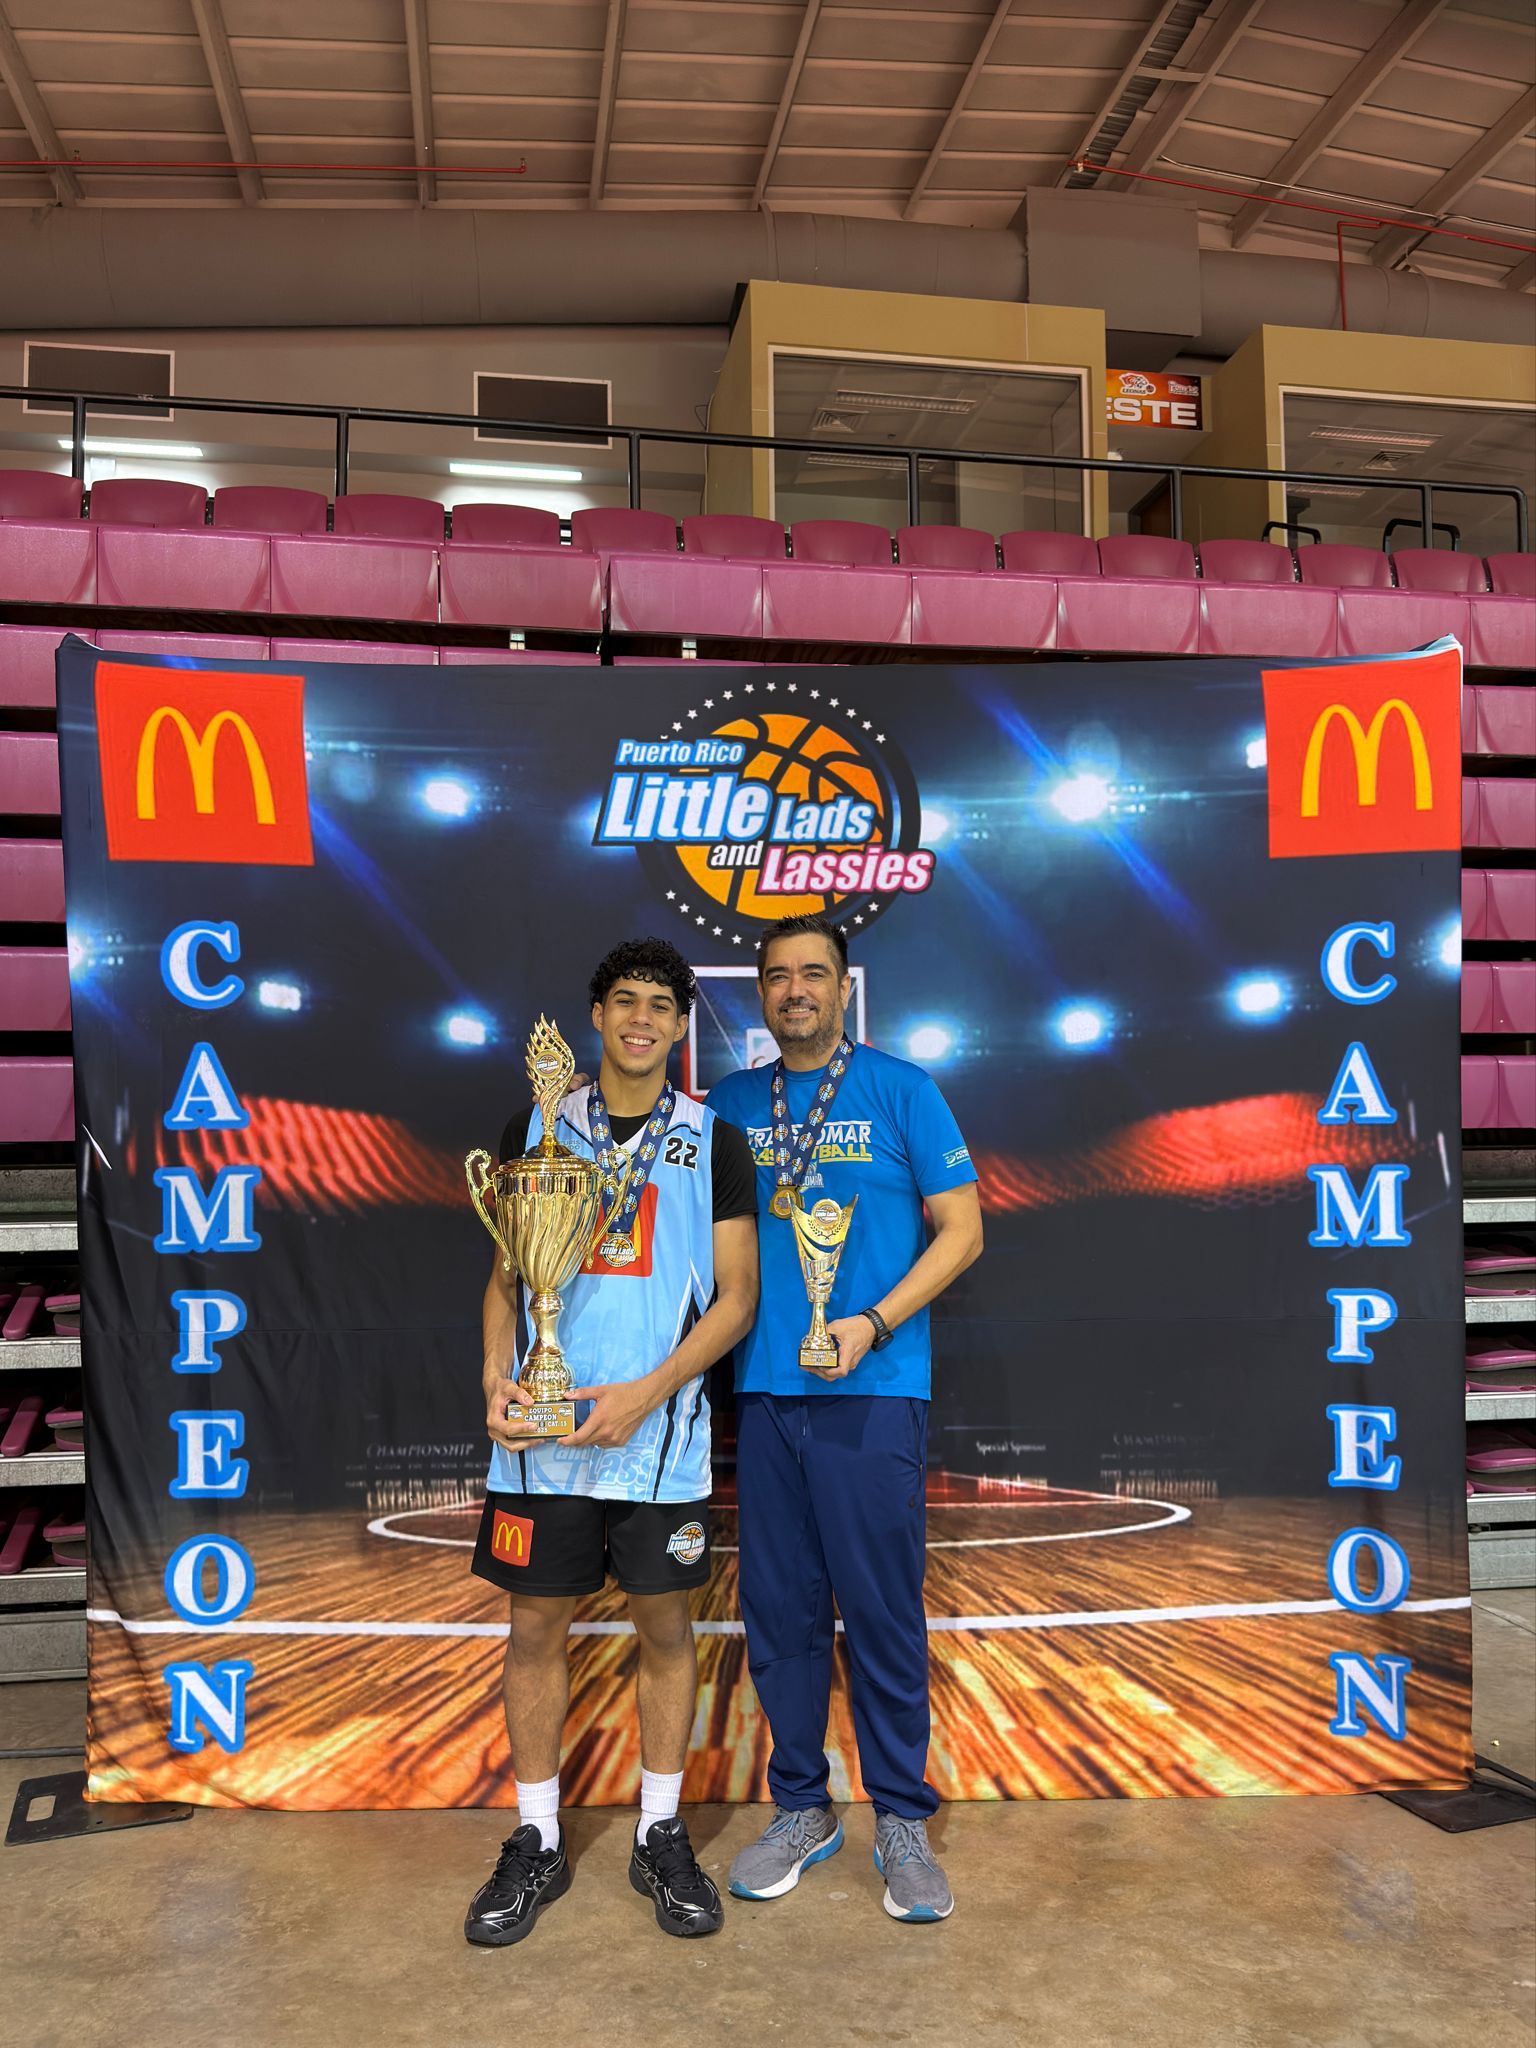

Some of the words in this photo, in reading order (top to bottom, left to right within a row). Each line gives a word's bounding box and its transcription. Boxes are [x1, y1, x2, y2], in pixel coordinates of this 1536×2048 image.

[1106, 397, 1197, 426] STE
[617, 741, 692, 765] Puerto
[694, 741, 744, 764] Rico
[602, 773, 771, 840] Little
[771, 797, 874, 841] Lads
[710, 841, 764, 867] and
[758, 846, 934, 893] Lassies
[664, 1136, 699, 1171] 22
[524, 1414, 557, 1422] CAMPEON
